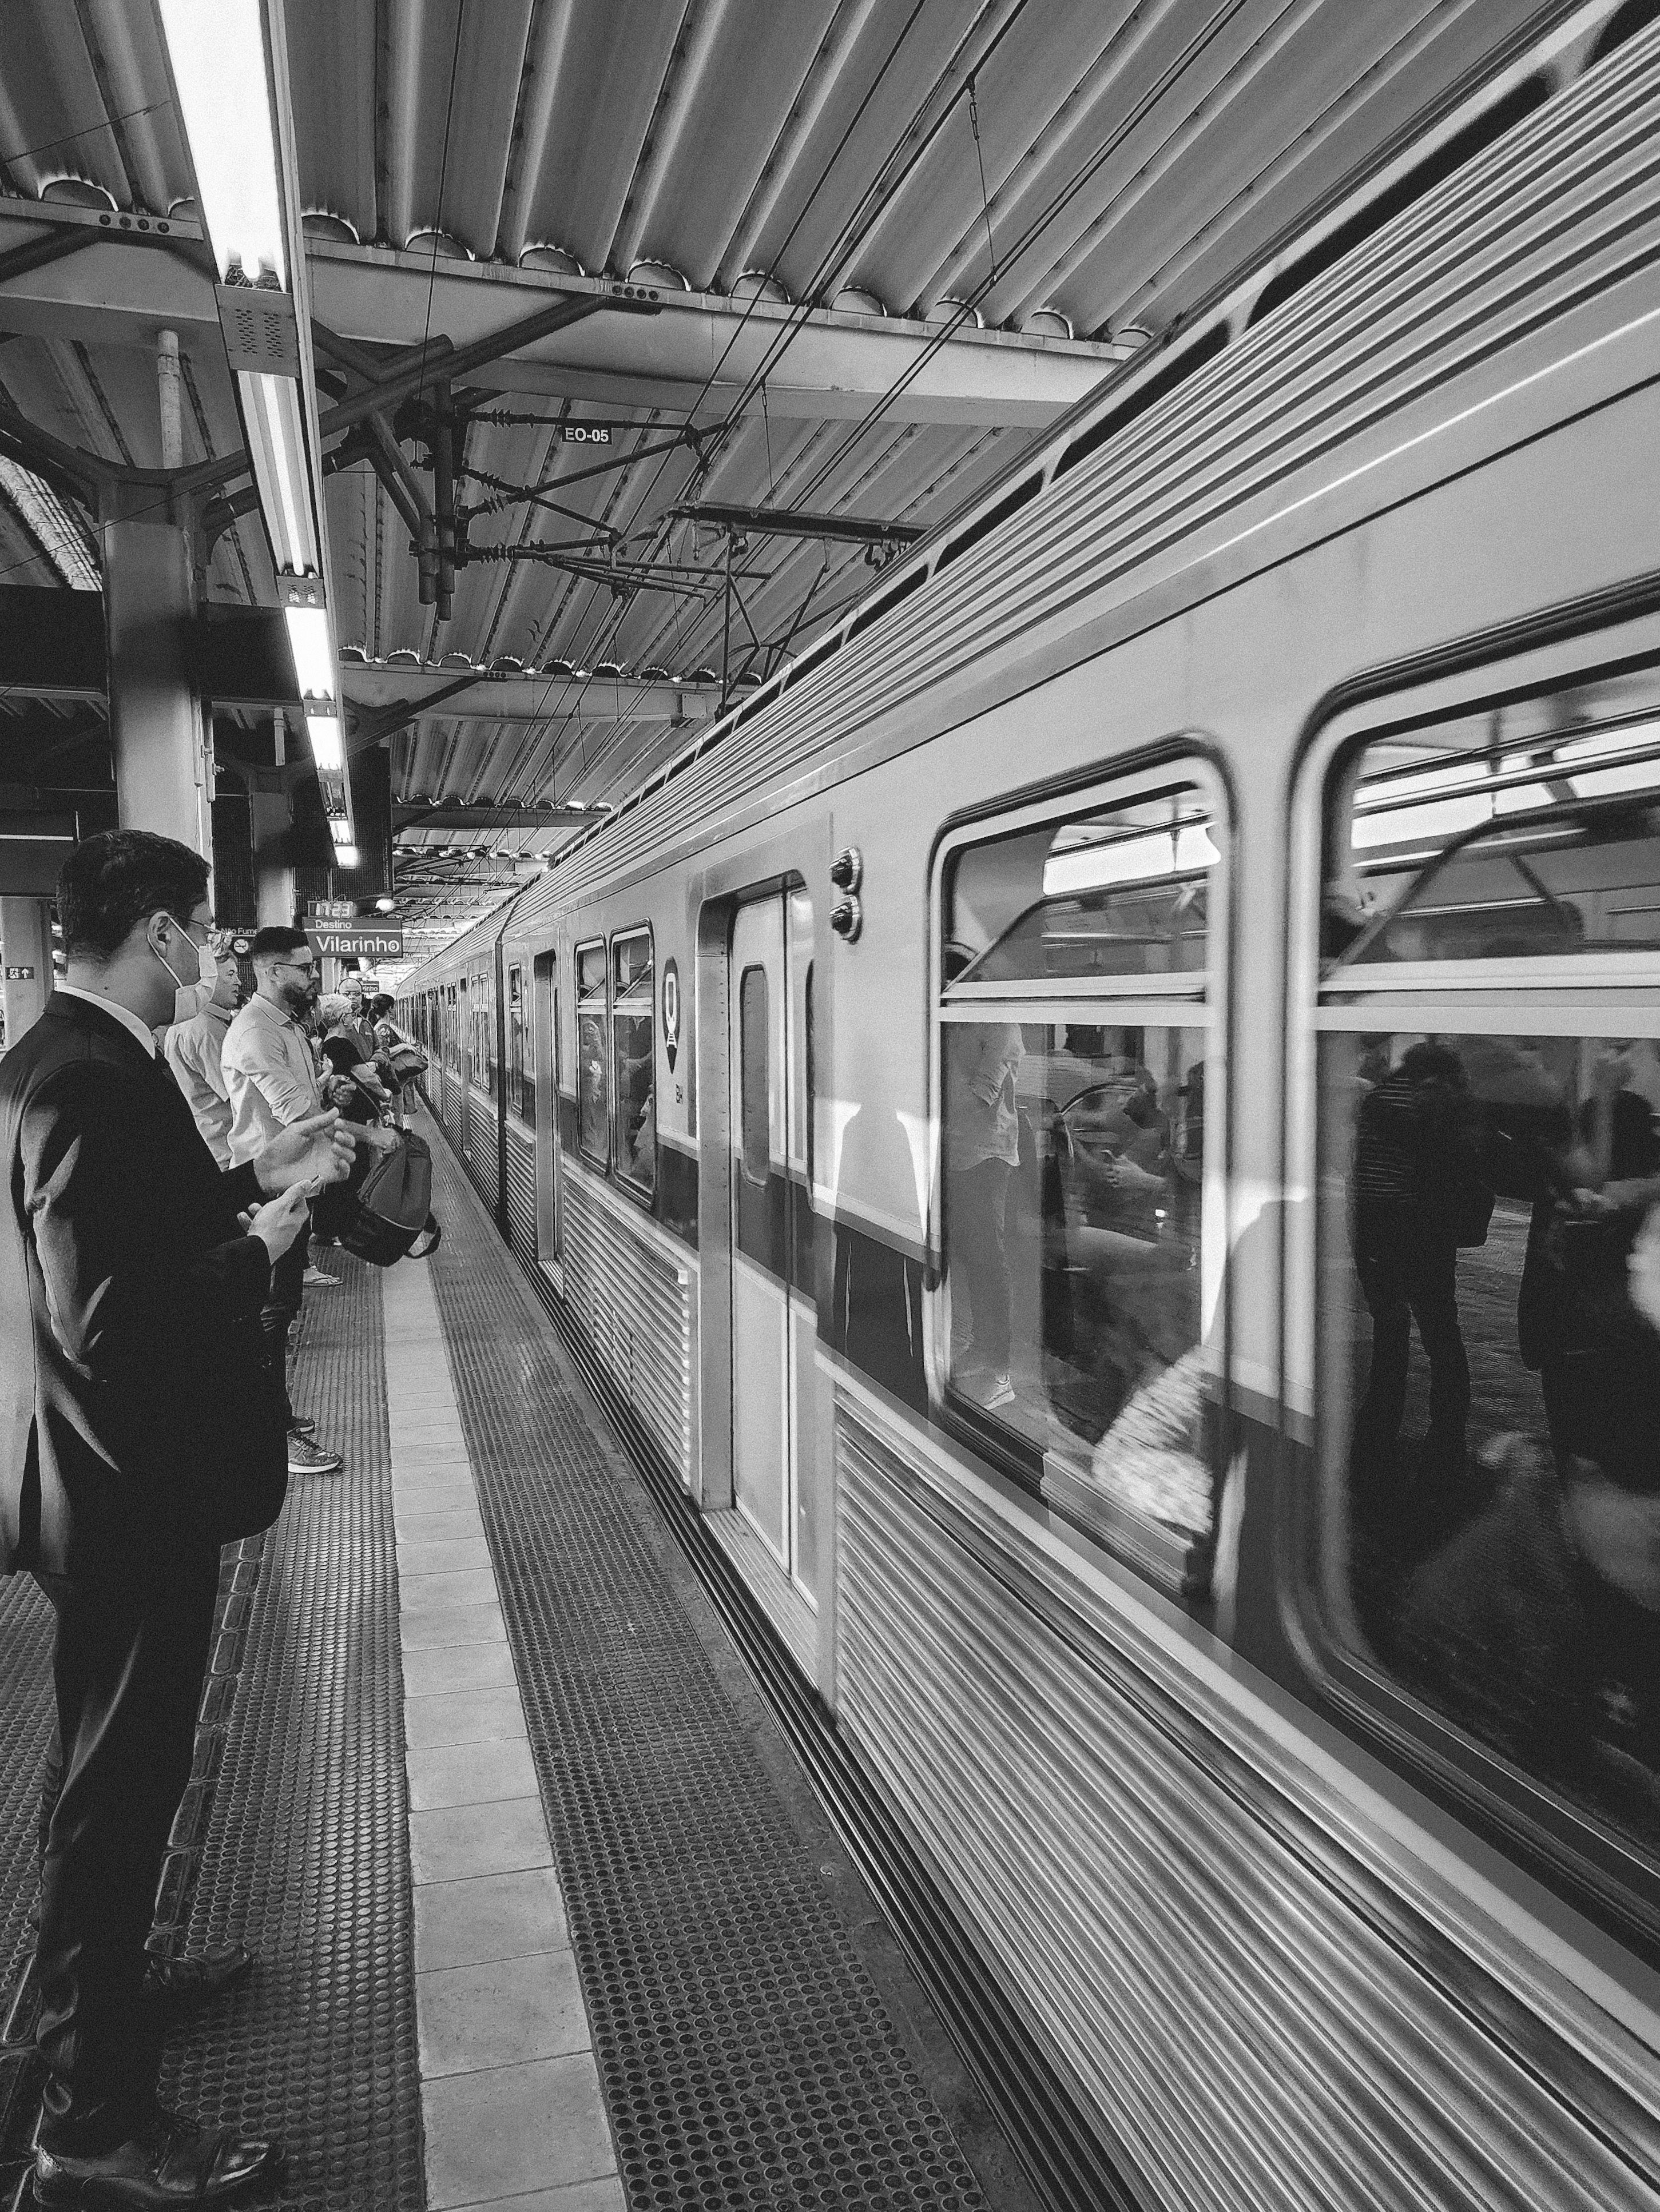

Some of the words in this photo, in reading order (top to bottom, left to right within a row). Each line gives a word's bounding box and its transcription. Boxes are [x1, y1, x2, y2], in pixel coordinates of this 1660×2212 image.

[565, 428, 609, 442] EO-05
[315, 920, 352, 929] Destino
[316, 936, 400, 952] Vilarinho
